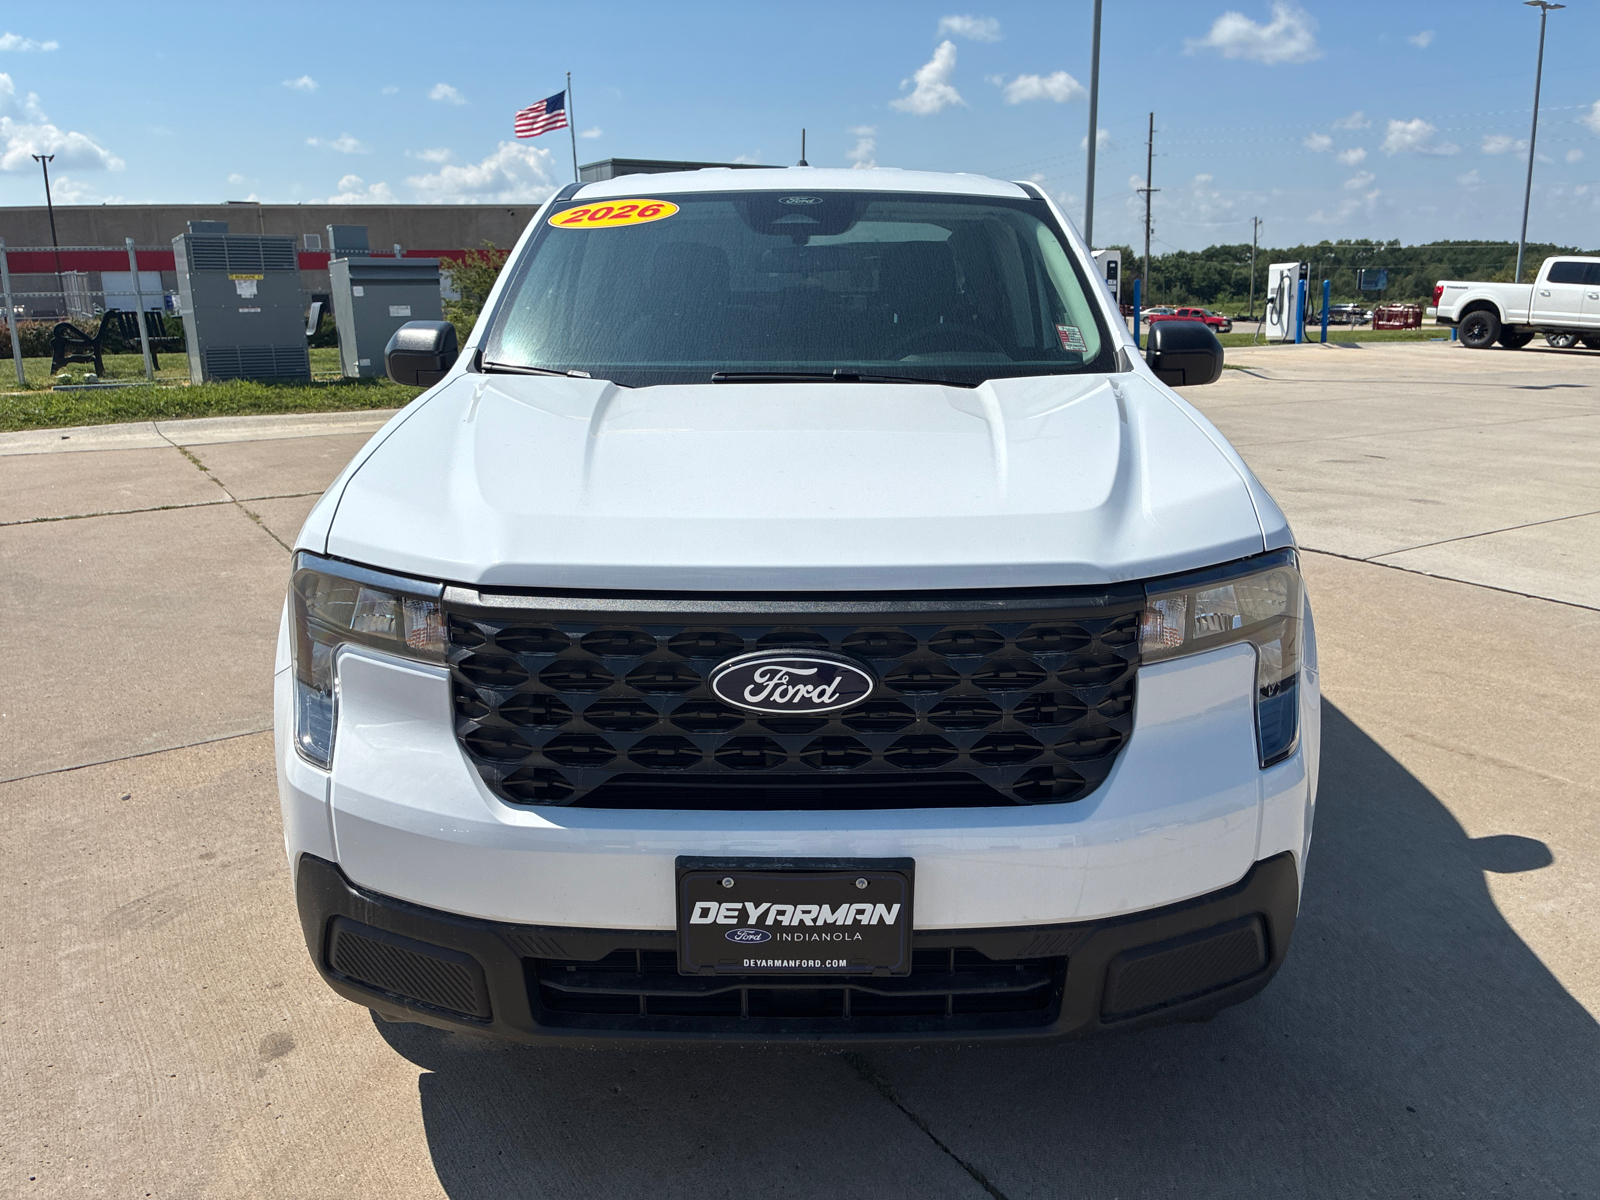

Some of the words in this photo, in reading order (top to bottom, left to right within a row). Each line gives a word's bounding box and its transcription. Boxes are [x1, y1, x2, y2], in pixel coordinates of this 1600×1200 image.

[560, 203, 666, 225] 2026
[743, 665, 843, 704] Ford
[689, 901, 901, 926] DEYARMAN
[734, 930, 762, 941] Ford
[776, 932, 863, 942] INDIANOLA
[743, 958, 847, 968] DEYARMANFORD.COM
